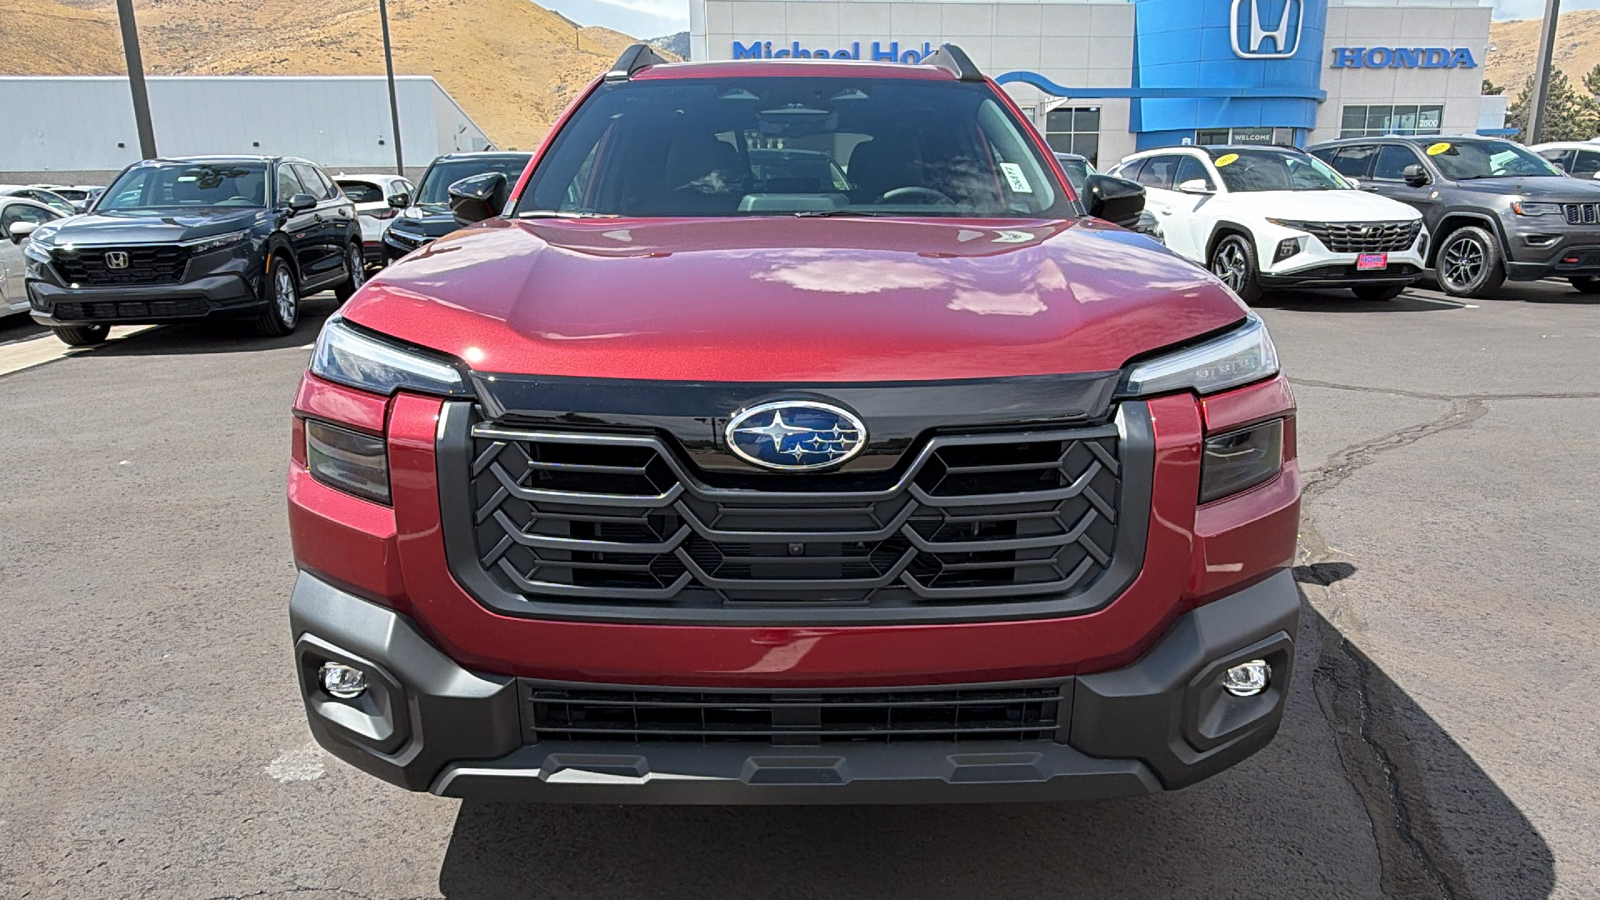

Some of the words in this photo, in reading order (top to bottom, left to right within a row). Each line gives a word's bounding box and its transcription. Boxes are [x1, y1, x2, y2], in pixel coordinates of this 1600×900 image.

[732, 41, 860, 60] Michael
[872, 41, 950, 65] Ho
[1331, 46, 1478, 69] HONDA
